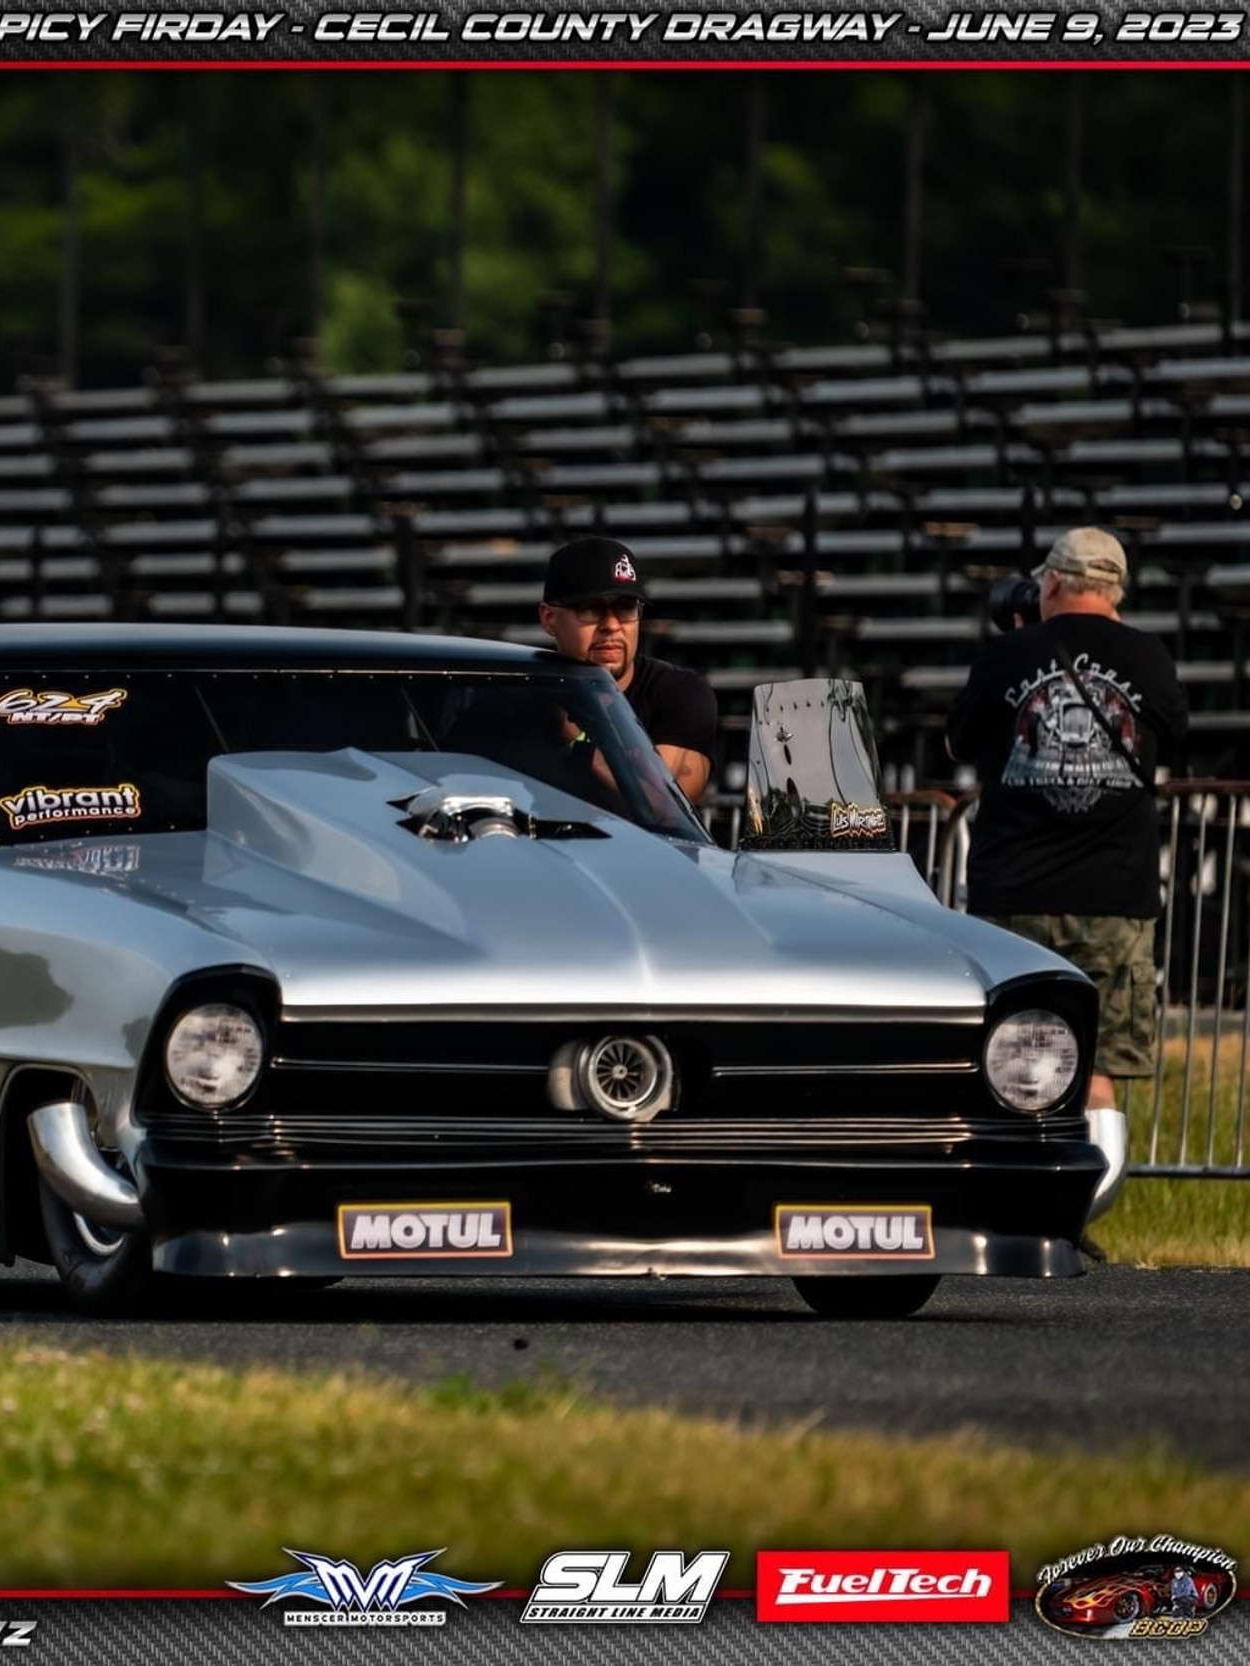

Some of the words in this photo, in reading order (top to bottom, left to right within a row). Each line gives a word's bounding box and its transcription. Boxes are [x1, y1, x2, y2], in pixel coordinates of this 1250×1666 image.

[4, 787, 137, 815] vibrant
[14, 806, 137, 826] performance
[351, 1213, 501, 1249] MOTUL
[787, 1215, 924, 1250] MOTUL
